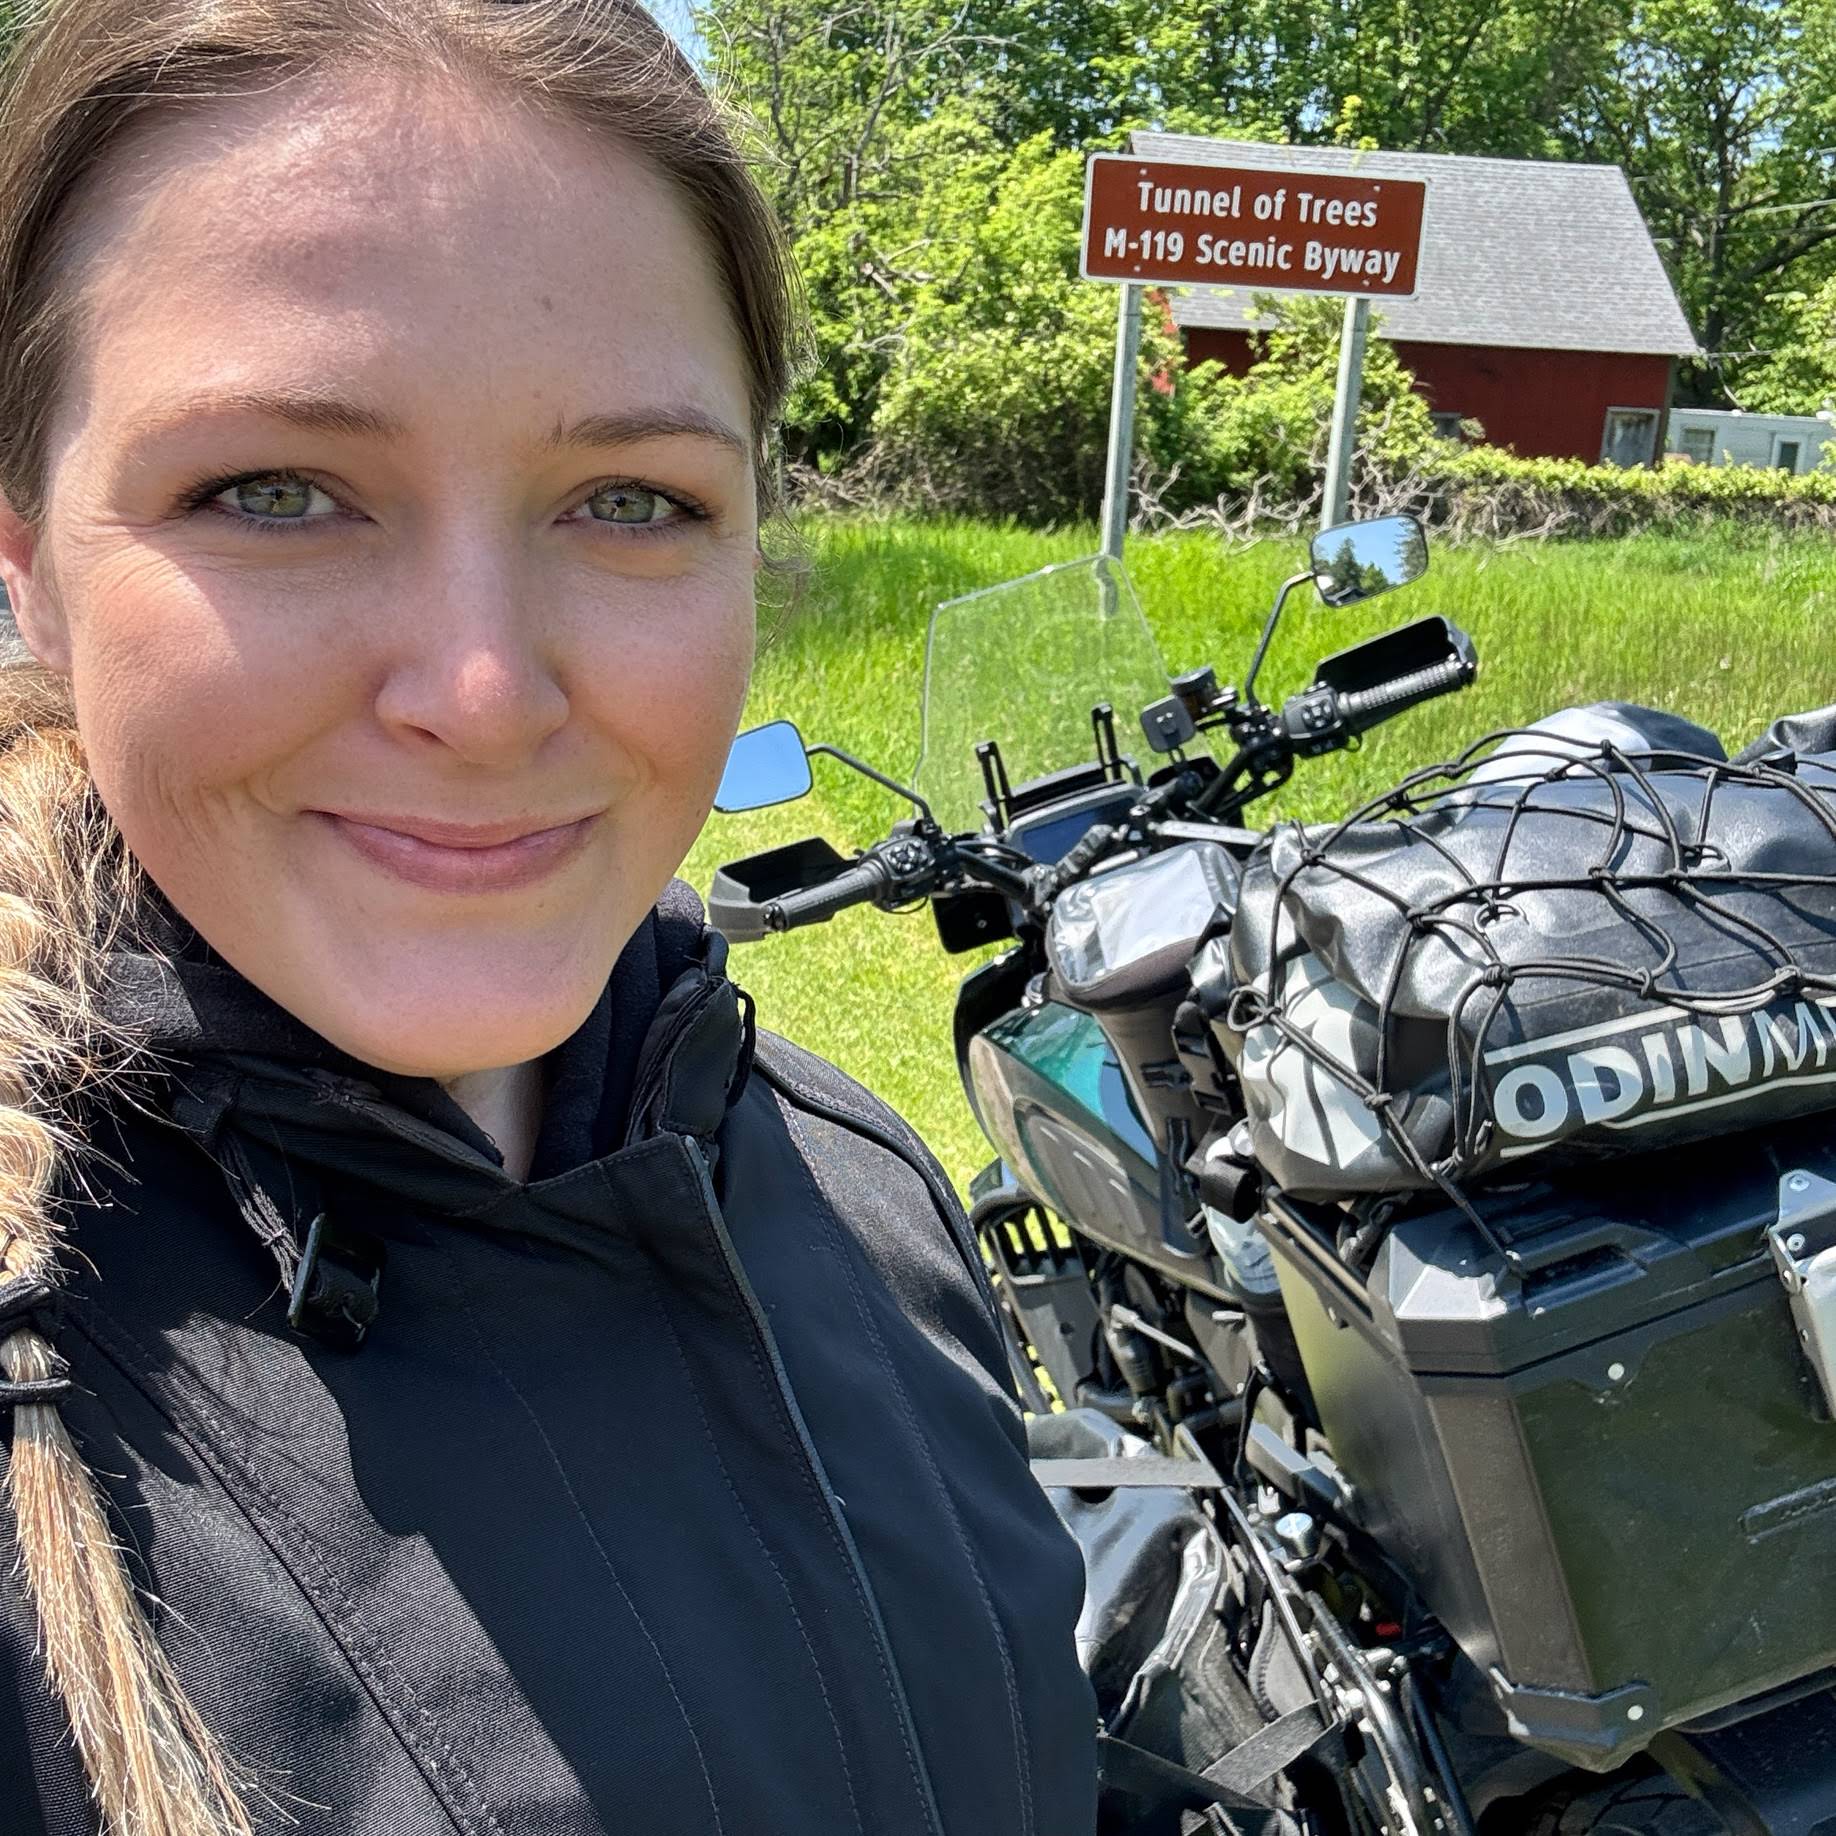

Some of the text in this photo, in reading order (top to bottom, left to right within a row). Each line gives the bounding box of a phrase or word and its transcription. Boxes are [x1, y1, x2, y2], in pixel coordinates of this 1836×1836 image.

[1138, 182, 1378, 227] Tunnel of Trees
[1104, 228, 1400, 283] M-119 Scenic Byway
